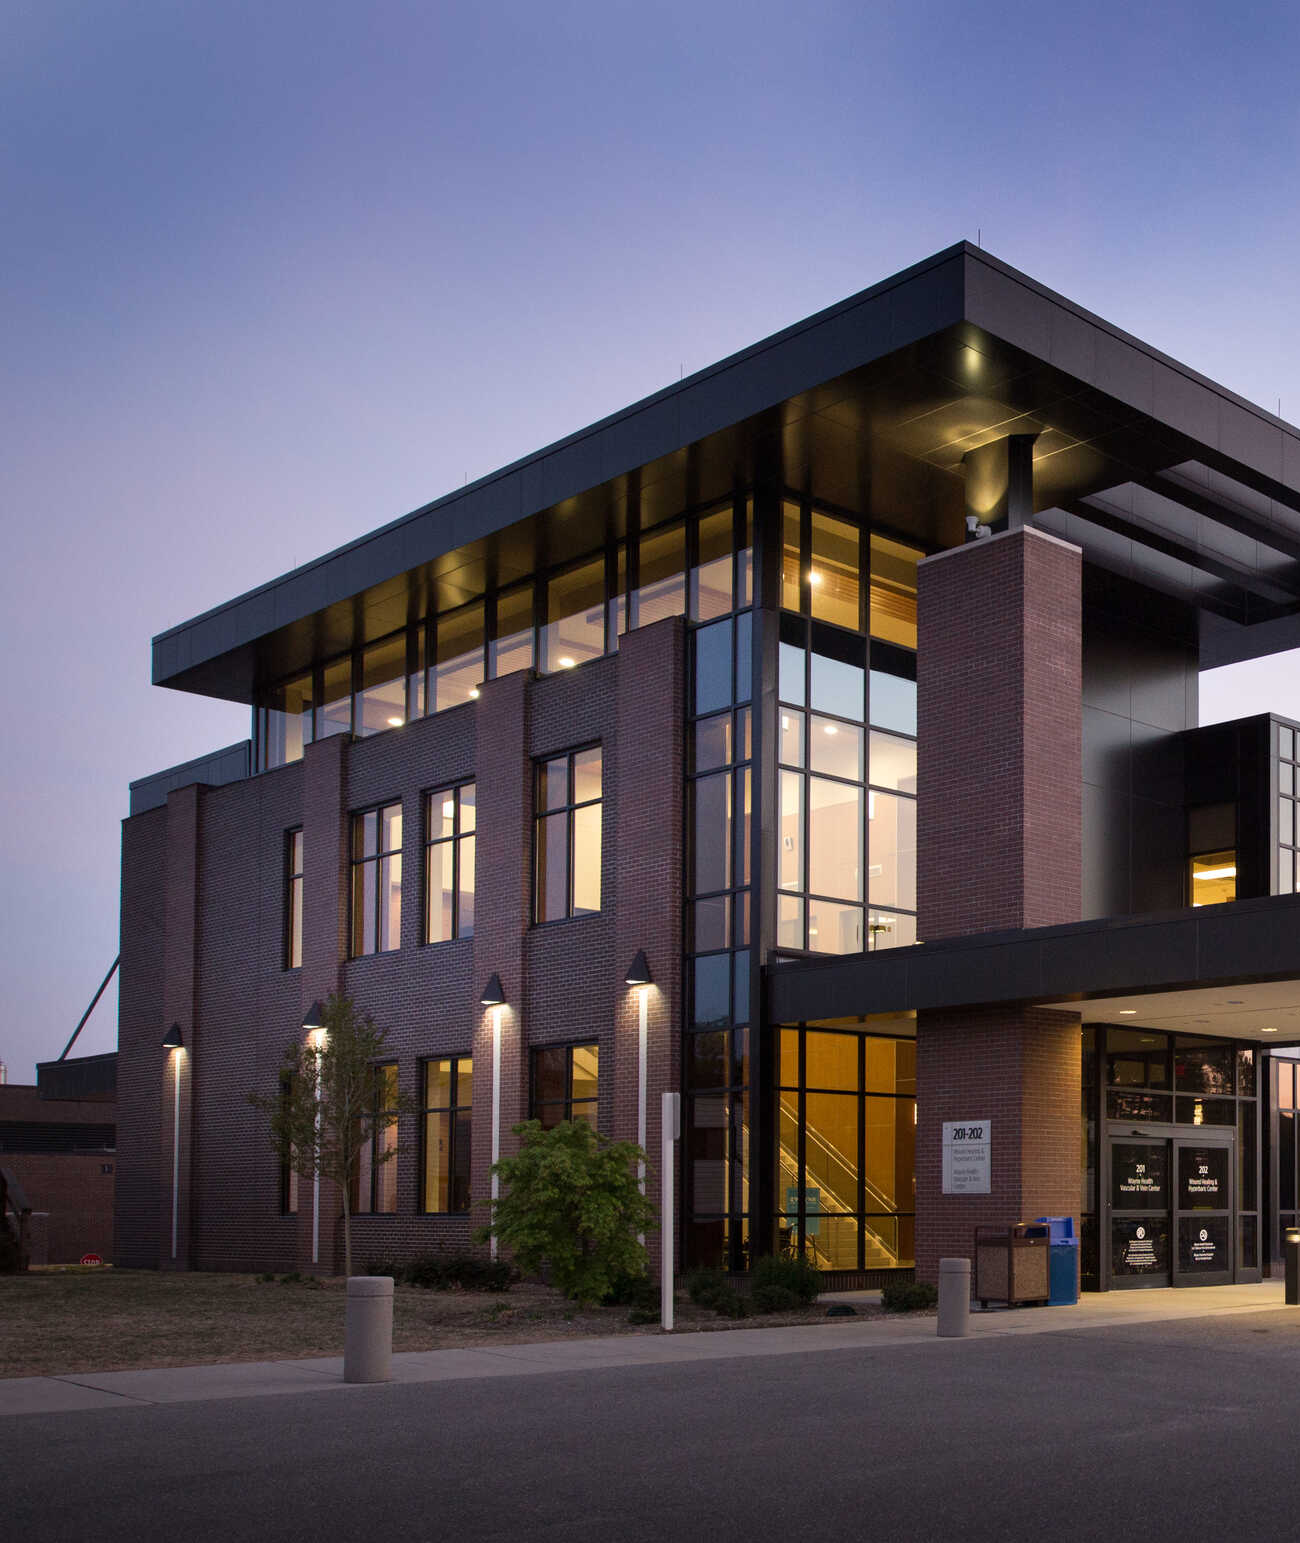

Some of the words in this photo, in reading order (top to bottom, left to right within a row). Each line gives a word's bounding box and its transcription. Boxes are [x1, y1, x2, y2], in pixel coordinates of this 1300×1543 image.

[953, 1128, 983, 1140] 201-202
[1136, 1164, 1145, 1173] 201
[1198, 1166, 1208, 1174] 202
